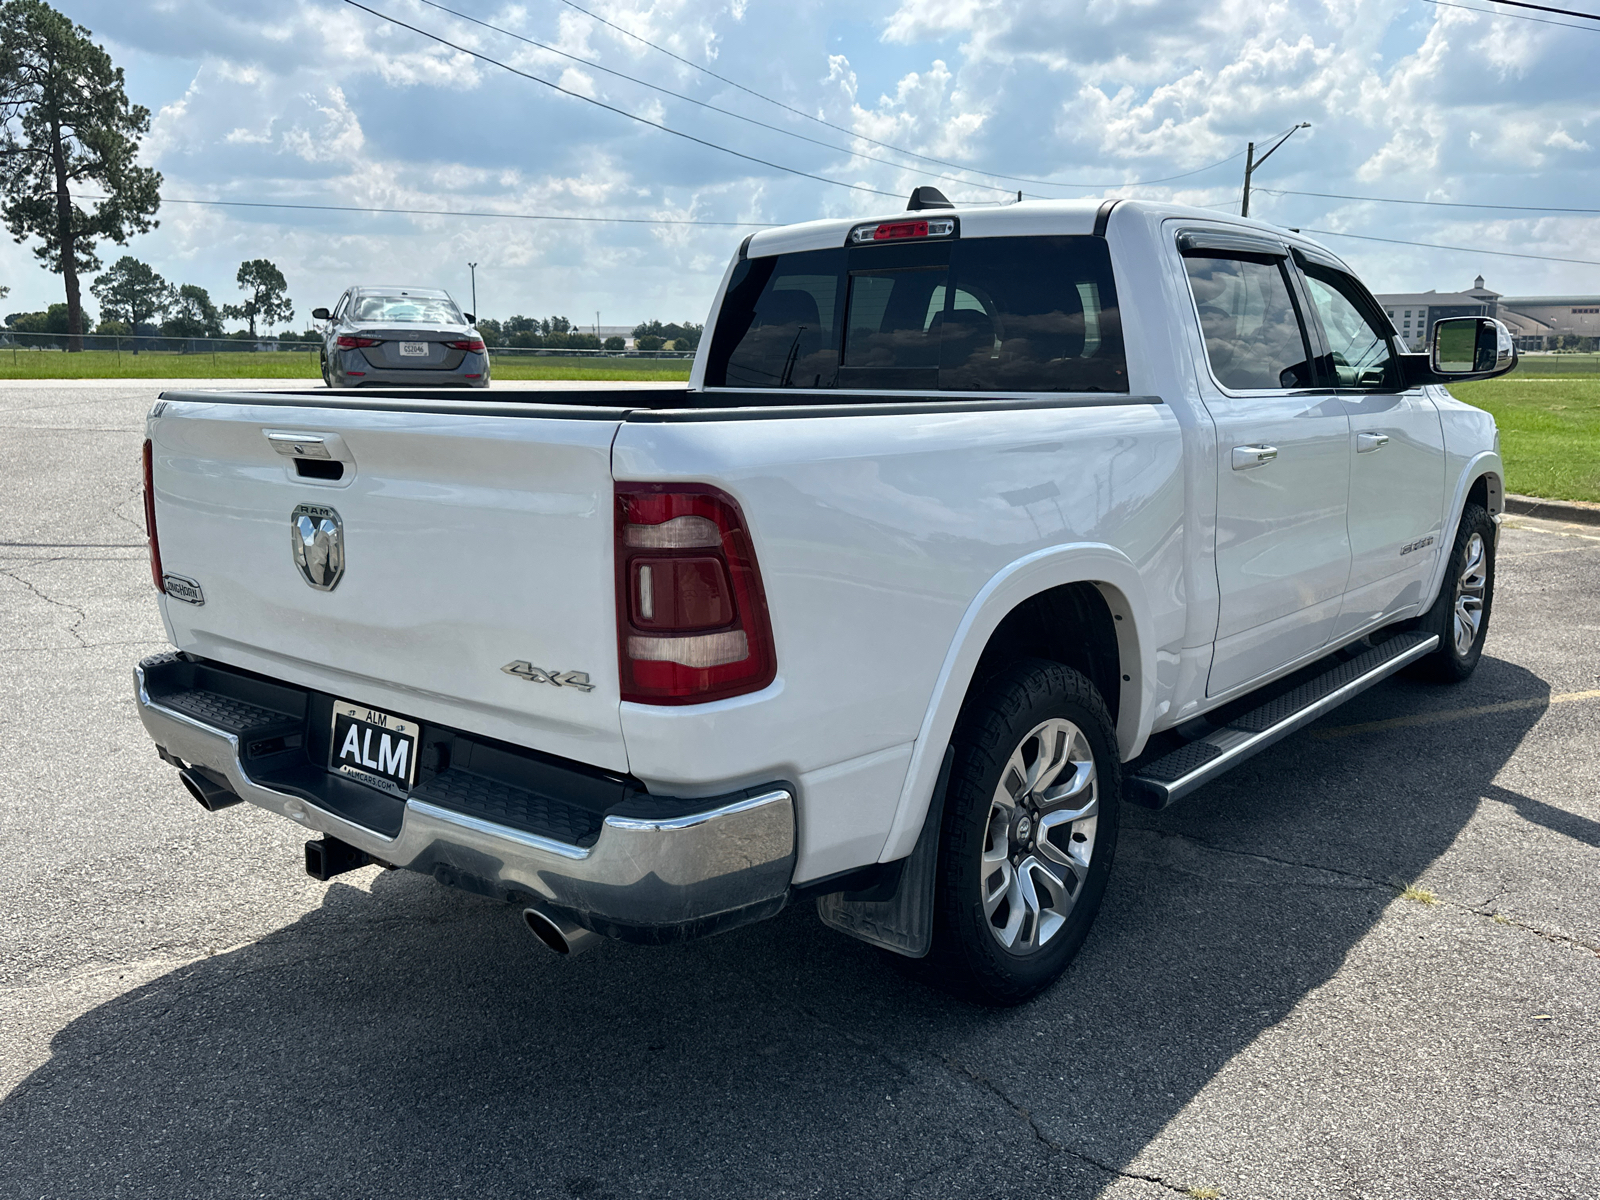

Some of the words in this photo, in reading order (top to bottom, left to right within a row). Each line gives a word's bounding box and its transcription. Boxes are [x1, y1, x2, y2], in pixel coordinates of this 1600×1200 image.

[300, 505, 329, 516] RAM
[366, 710, 388, 728] ALM
[339, 723, 410, 780] ALM
[346, 768, 393, 792] ALMCARS.COM
